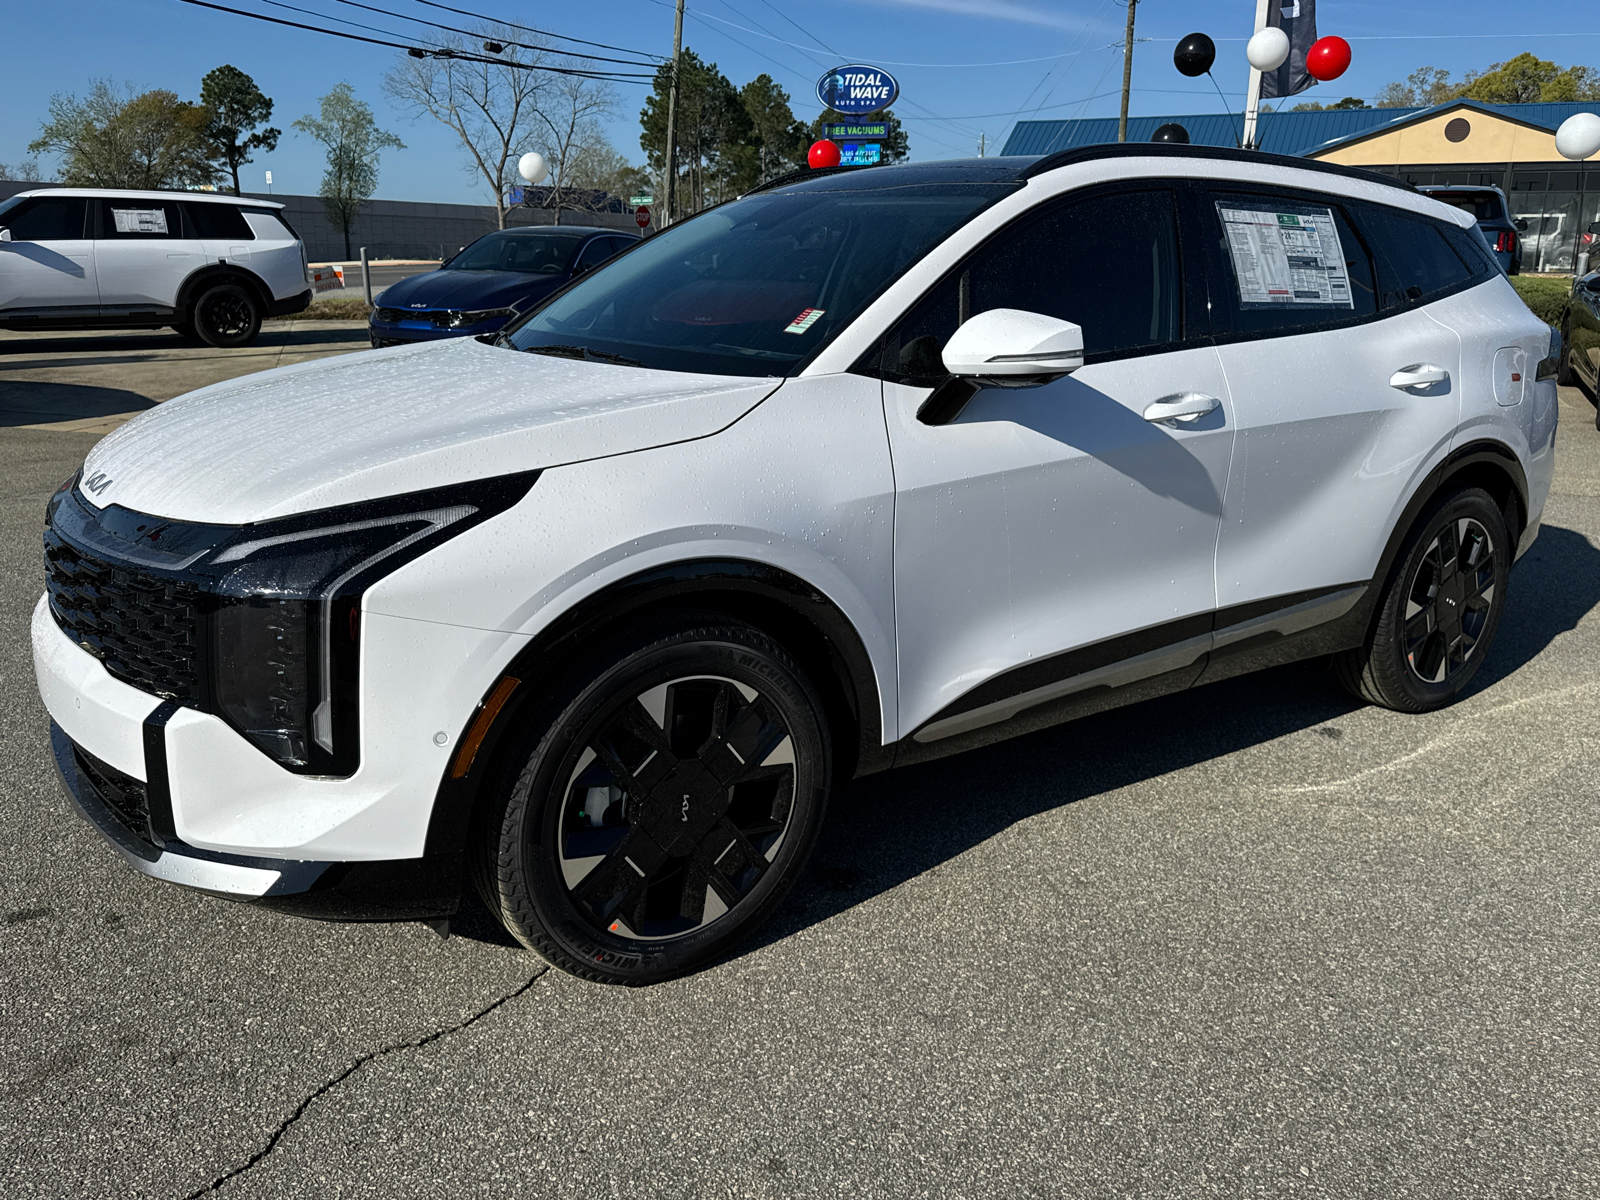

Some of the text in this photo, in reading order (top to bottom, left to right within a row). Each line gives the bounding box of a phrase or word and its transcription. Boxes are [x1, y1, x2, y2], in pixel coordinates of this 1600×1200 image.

[844, 74, 882, 86] TIDAL
[850, 86, 889, 99] WAVE
[824, 126, 885, 135] FREE VACUUMS
[636, 212, 650, 222] STOP
[84, 469, 114, 497] KIA
[681, 794, 690, 822] KIA
